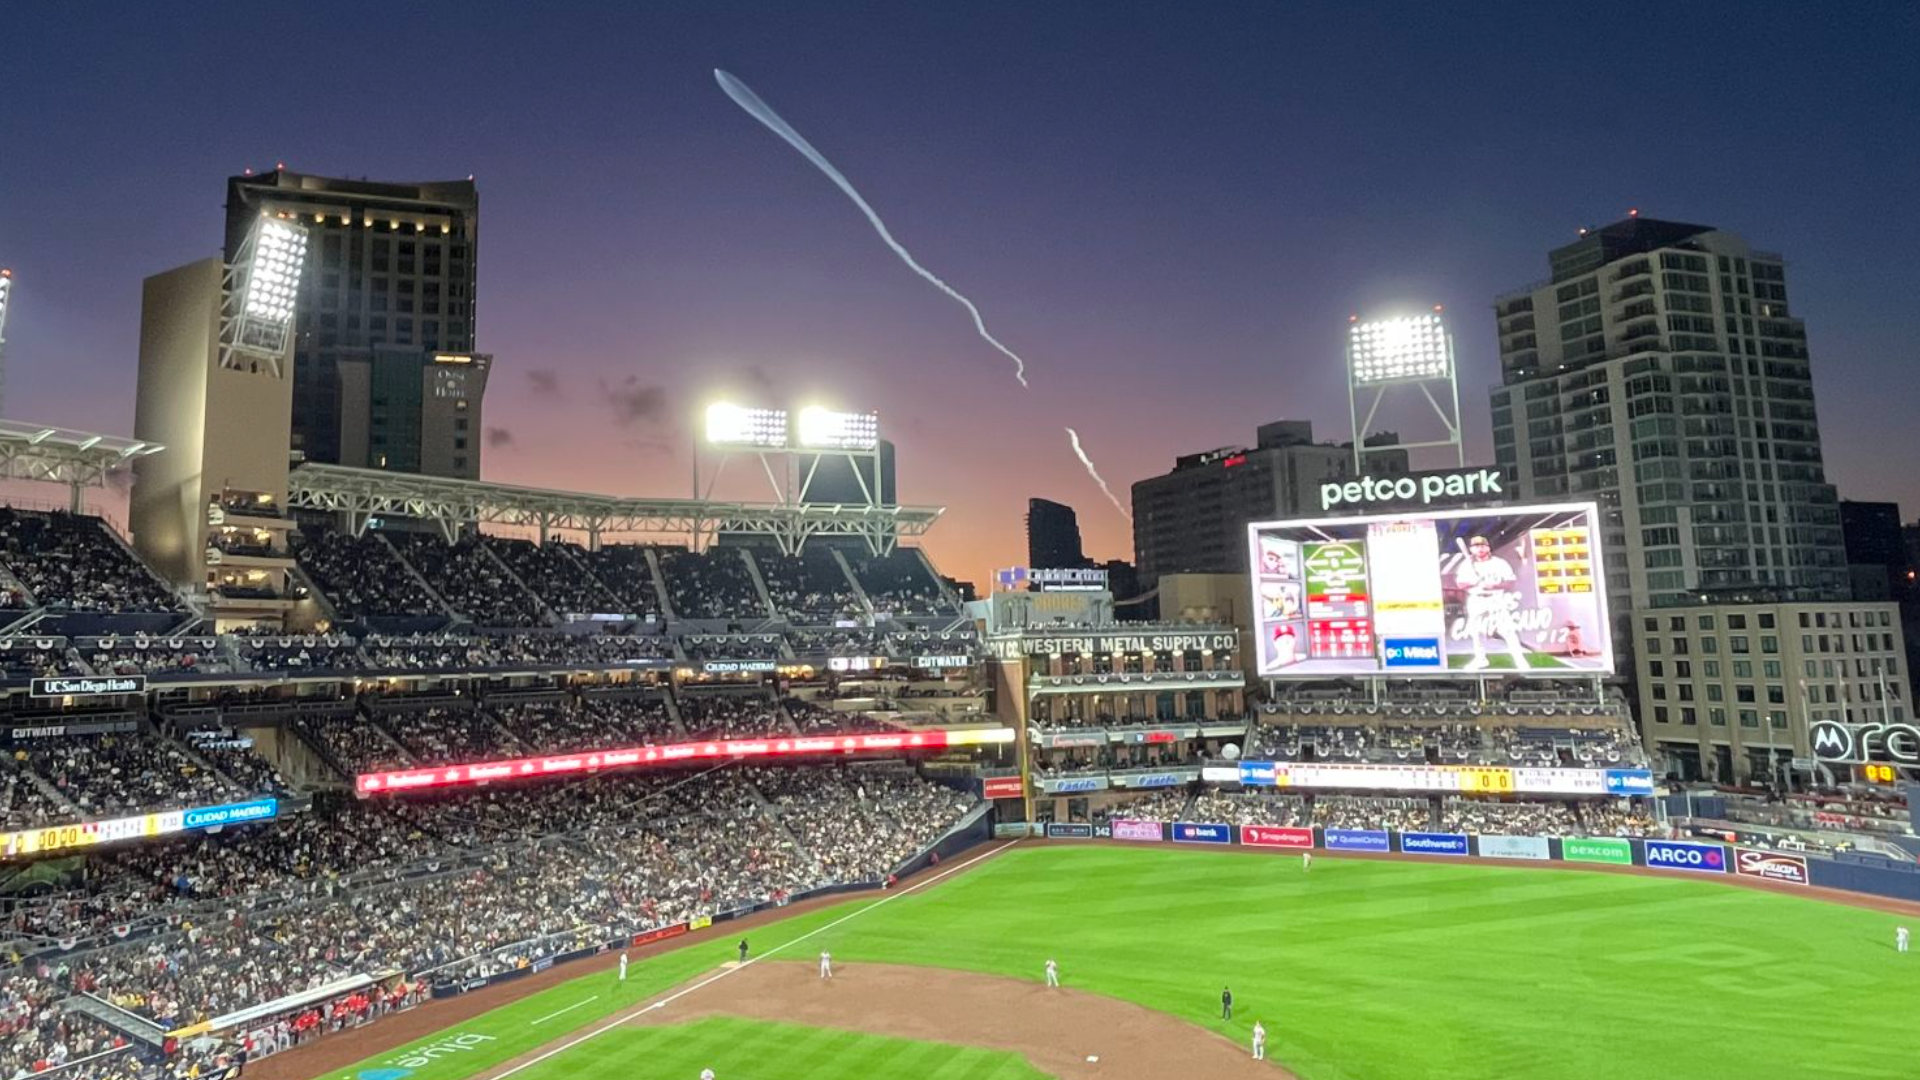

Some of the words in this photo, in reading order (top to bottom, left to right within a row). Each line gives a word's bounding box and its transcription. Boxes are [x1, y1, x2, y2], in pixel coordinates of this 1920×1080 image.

[1321, 473, 1417, 510] petco
[1423, 469, 1502, 503] park
[1022, 637, 1094, 654] WESTERN
[1100, 636, 1149, 652] METAL
[1152, 635, 1207, 651] SUPPLY
[1213, 635, 1238, 650] CO.
[918, 656, 968, 667] CUTWATER
[44, 681, 62, 693] UC
[62, 681, 80, 692] San
[80, 680, 106, 693] Diego
[107, 679, 136, 691] Health
[12, 726, 66, 739] CUTWATER
[186, 811, 228, 825] CIUDAD
[229, 805, 271, 819] MADERAS
[1095, 825, 1110, 837] 342
[1260, 832, 1309, 844] Snapdragon
[1405, 838, 1457, 850] Southwest
[1649, 847, 1702, 864] ARCO
